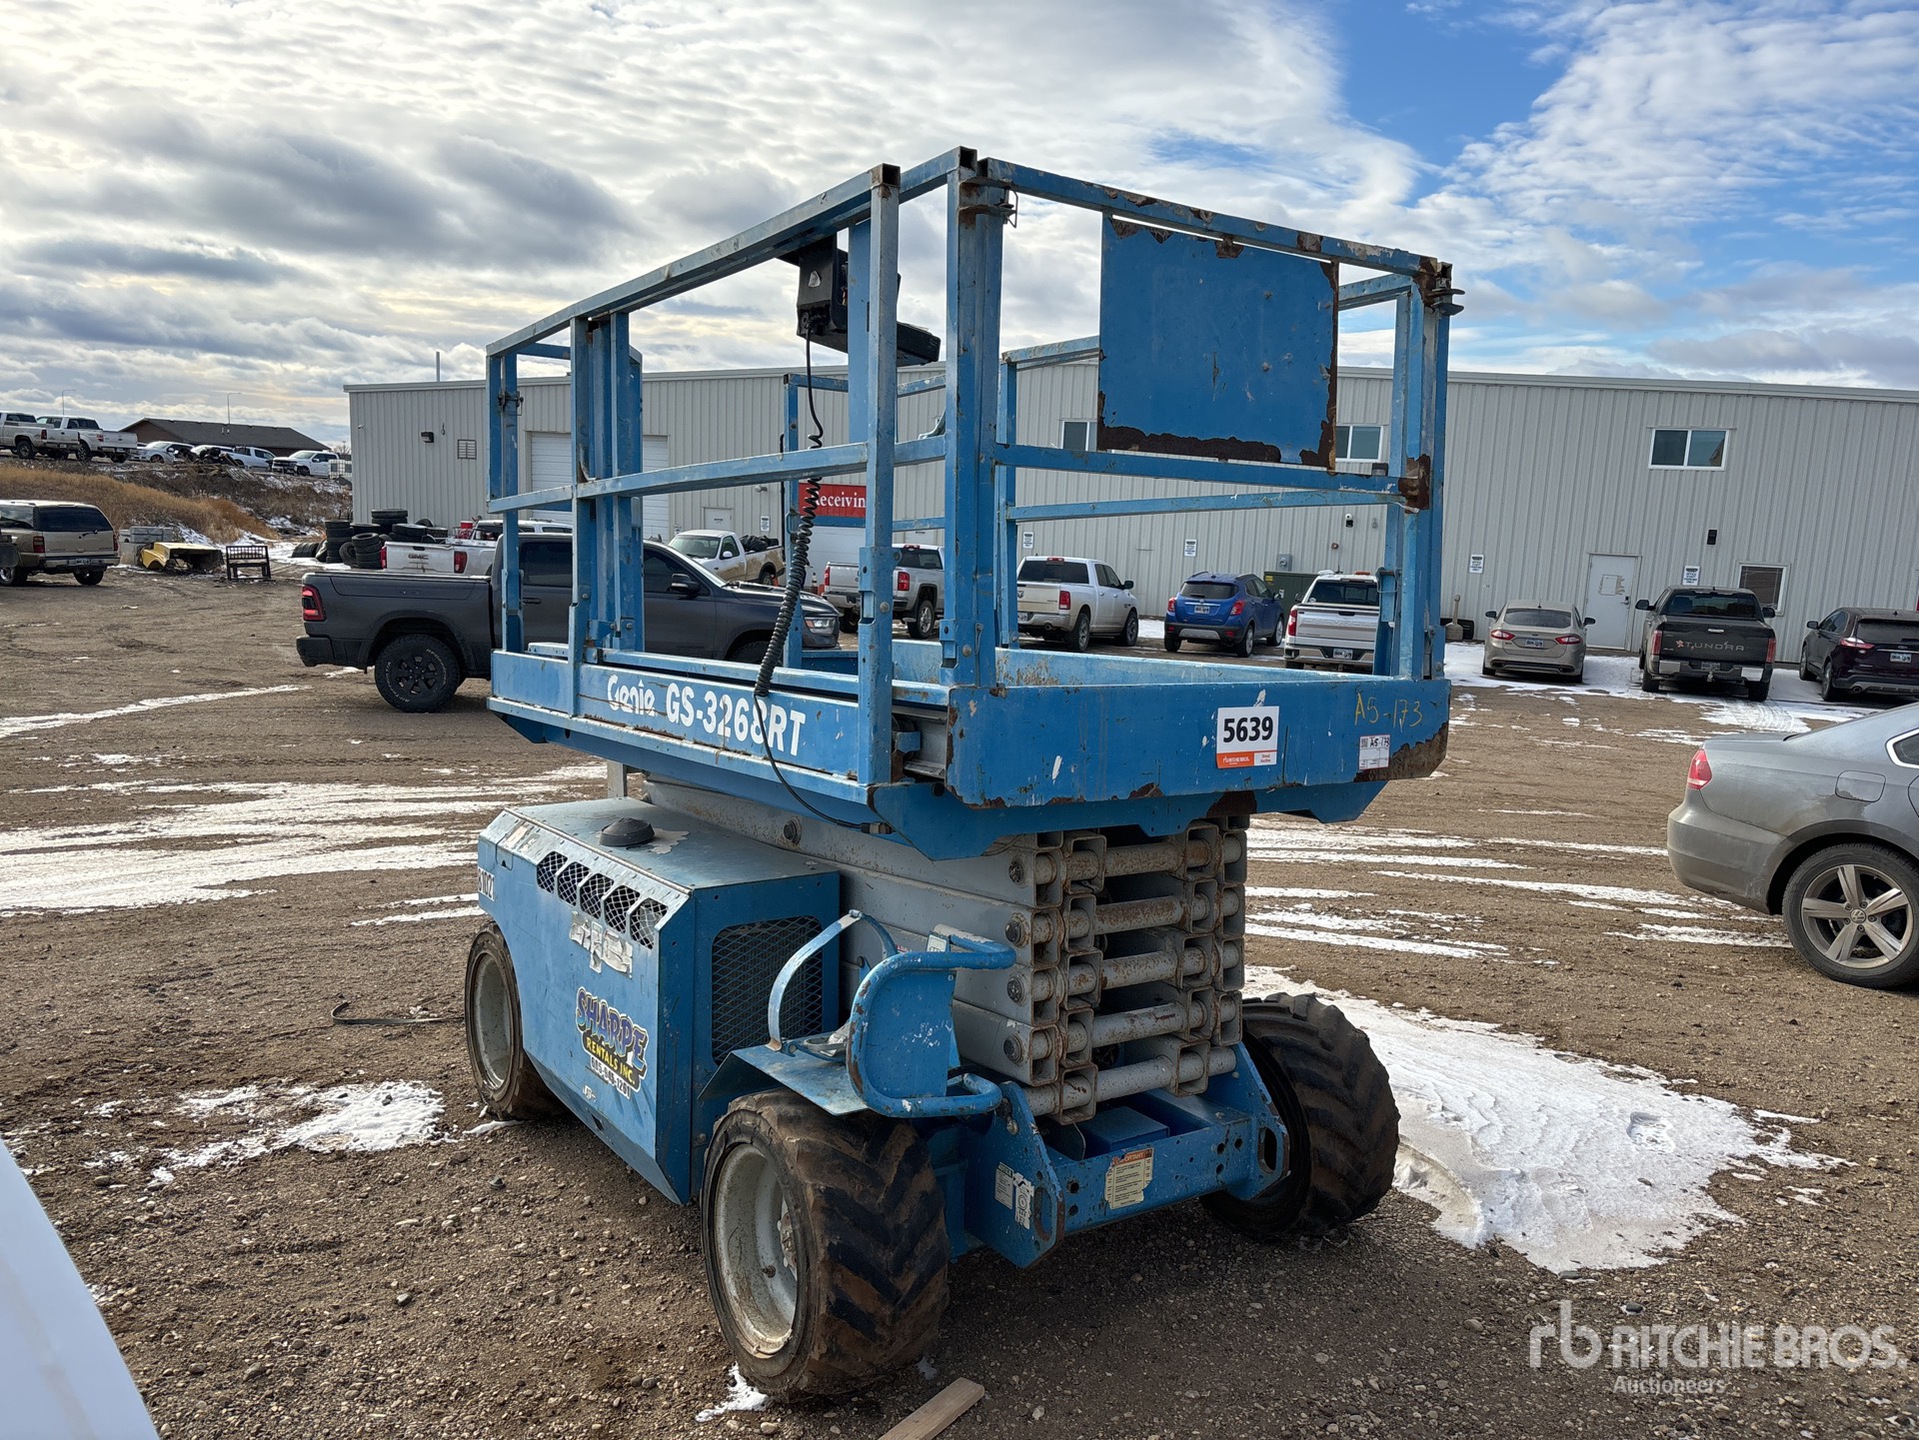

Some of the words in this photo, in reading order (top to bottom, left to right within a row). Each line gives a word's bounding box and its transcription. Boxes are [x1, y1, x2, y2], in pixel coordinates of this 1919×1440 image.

[812, 490, 867, 508] eceivin
[1685, 641, 1745, 652] TUNDRA
[607, 674, 656, 717] Genie
[666, 682, 806, 756] GS-3268RT
[1223, 716, 1274, 743] 5639
[576, 987, 649, 1076] SHARPE
[586, 1036, 619, 1071] RENTALS
[620, 1061, 636, 1085] INC.
